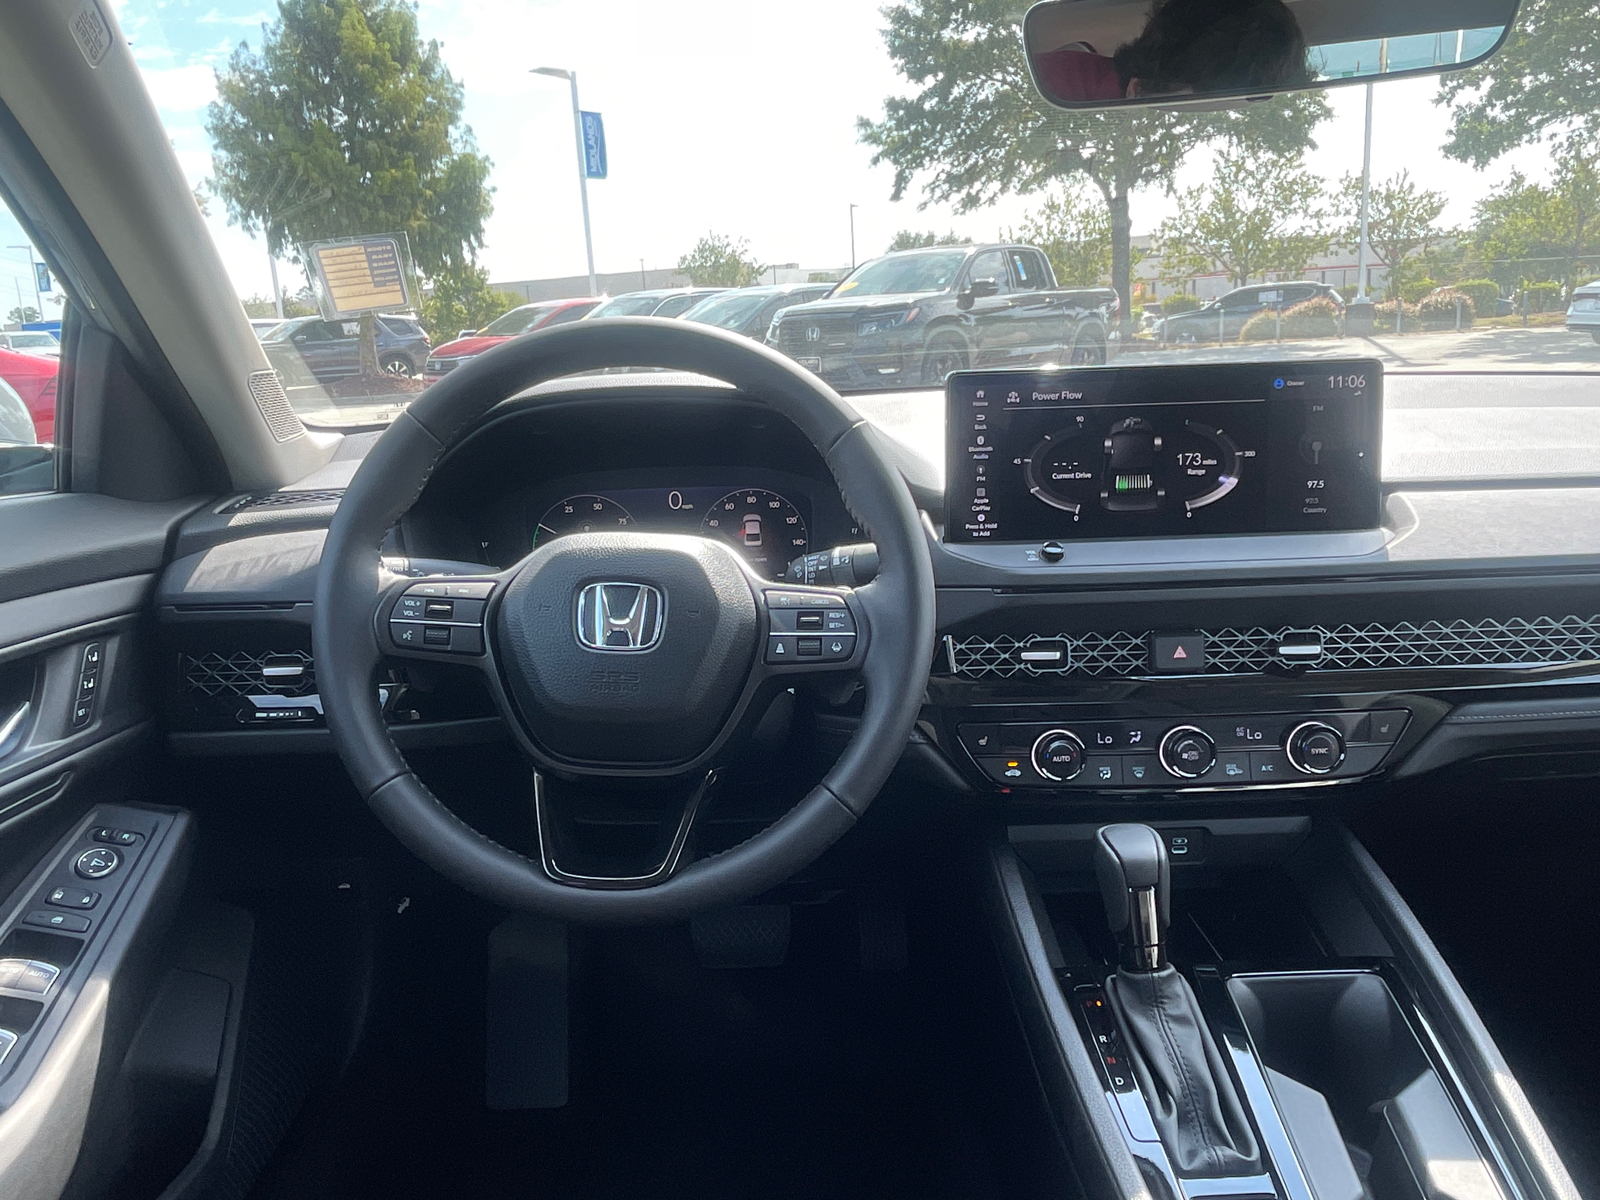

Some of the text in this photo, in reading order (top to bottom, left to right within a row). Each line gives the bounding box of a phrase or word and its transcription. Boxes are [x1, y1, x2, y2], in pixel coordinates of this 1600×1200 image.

[585, 115, 598, 173] MIDLANDS
[1328, 374, 1366, 389] 11:06
[1032, 390, 1083, 400] Power Flow
[1076, 415, 1085, 423] 90
[1176, 452, 1202, 466] 173
[1052, 471, 1092, 480] Current Drive
[1187, 468, 1206, 476] Range
[1307, 480, 1325, 488] 97.5
[668, 490, 683, 510] 0
[746, 496, 757, 504] 80
[593, 503, 602, 511] 50
[724, 502, 734, 511] 60
[768, 501, 780, 509] 100
[1303, 506, 1328, 514] Country
[618, 518, 627, 526] 75
[786, 516, 798, 524] 120
[1074, 514, 1080, 522] 0
[709, 519, 719, 527] 40
[792, 538, 804, 546] 140
[1097, 732, 1113, 744] Lo
[1246, 728, 1263, 740] Lo
[1310, 747, 1329, 755] SYNC
[28, 970, 50, 979] AUTO
[1098, 1034, 1108, 1044] R
[1106, 1056, 1117, 1064] N
[1114, 1076, 1125, 1086] D
